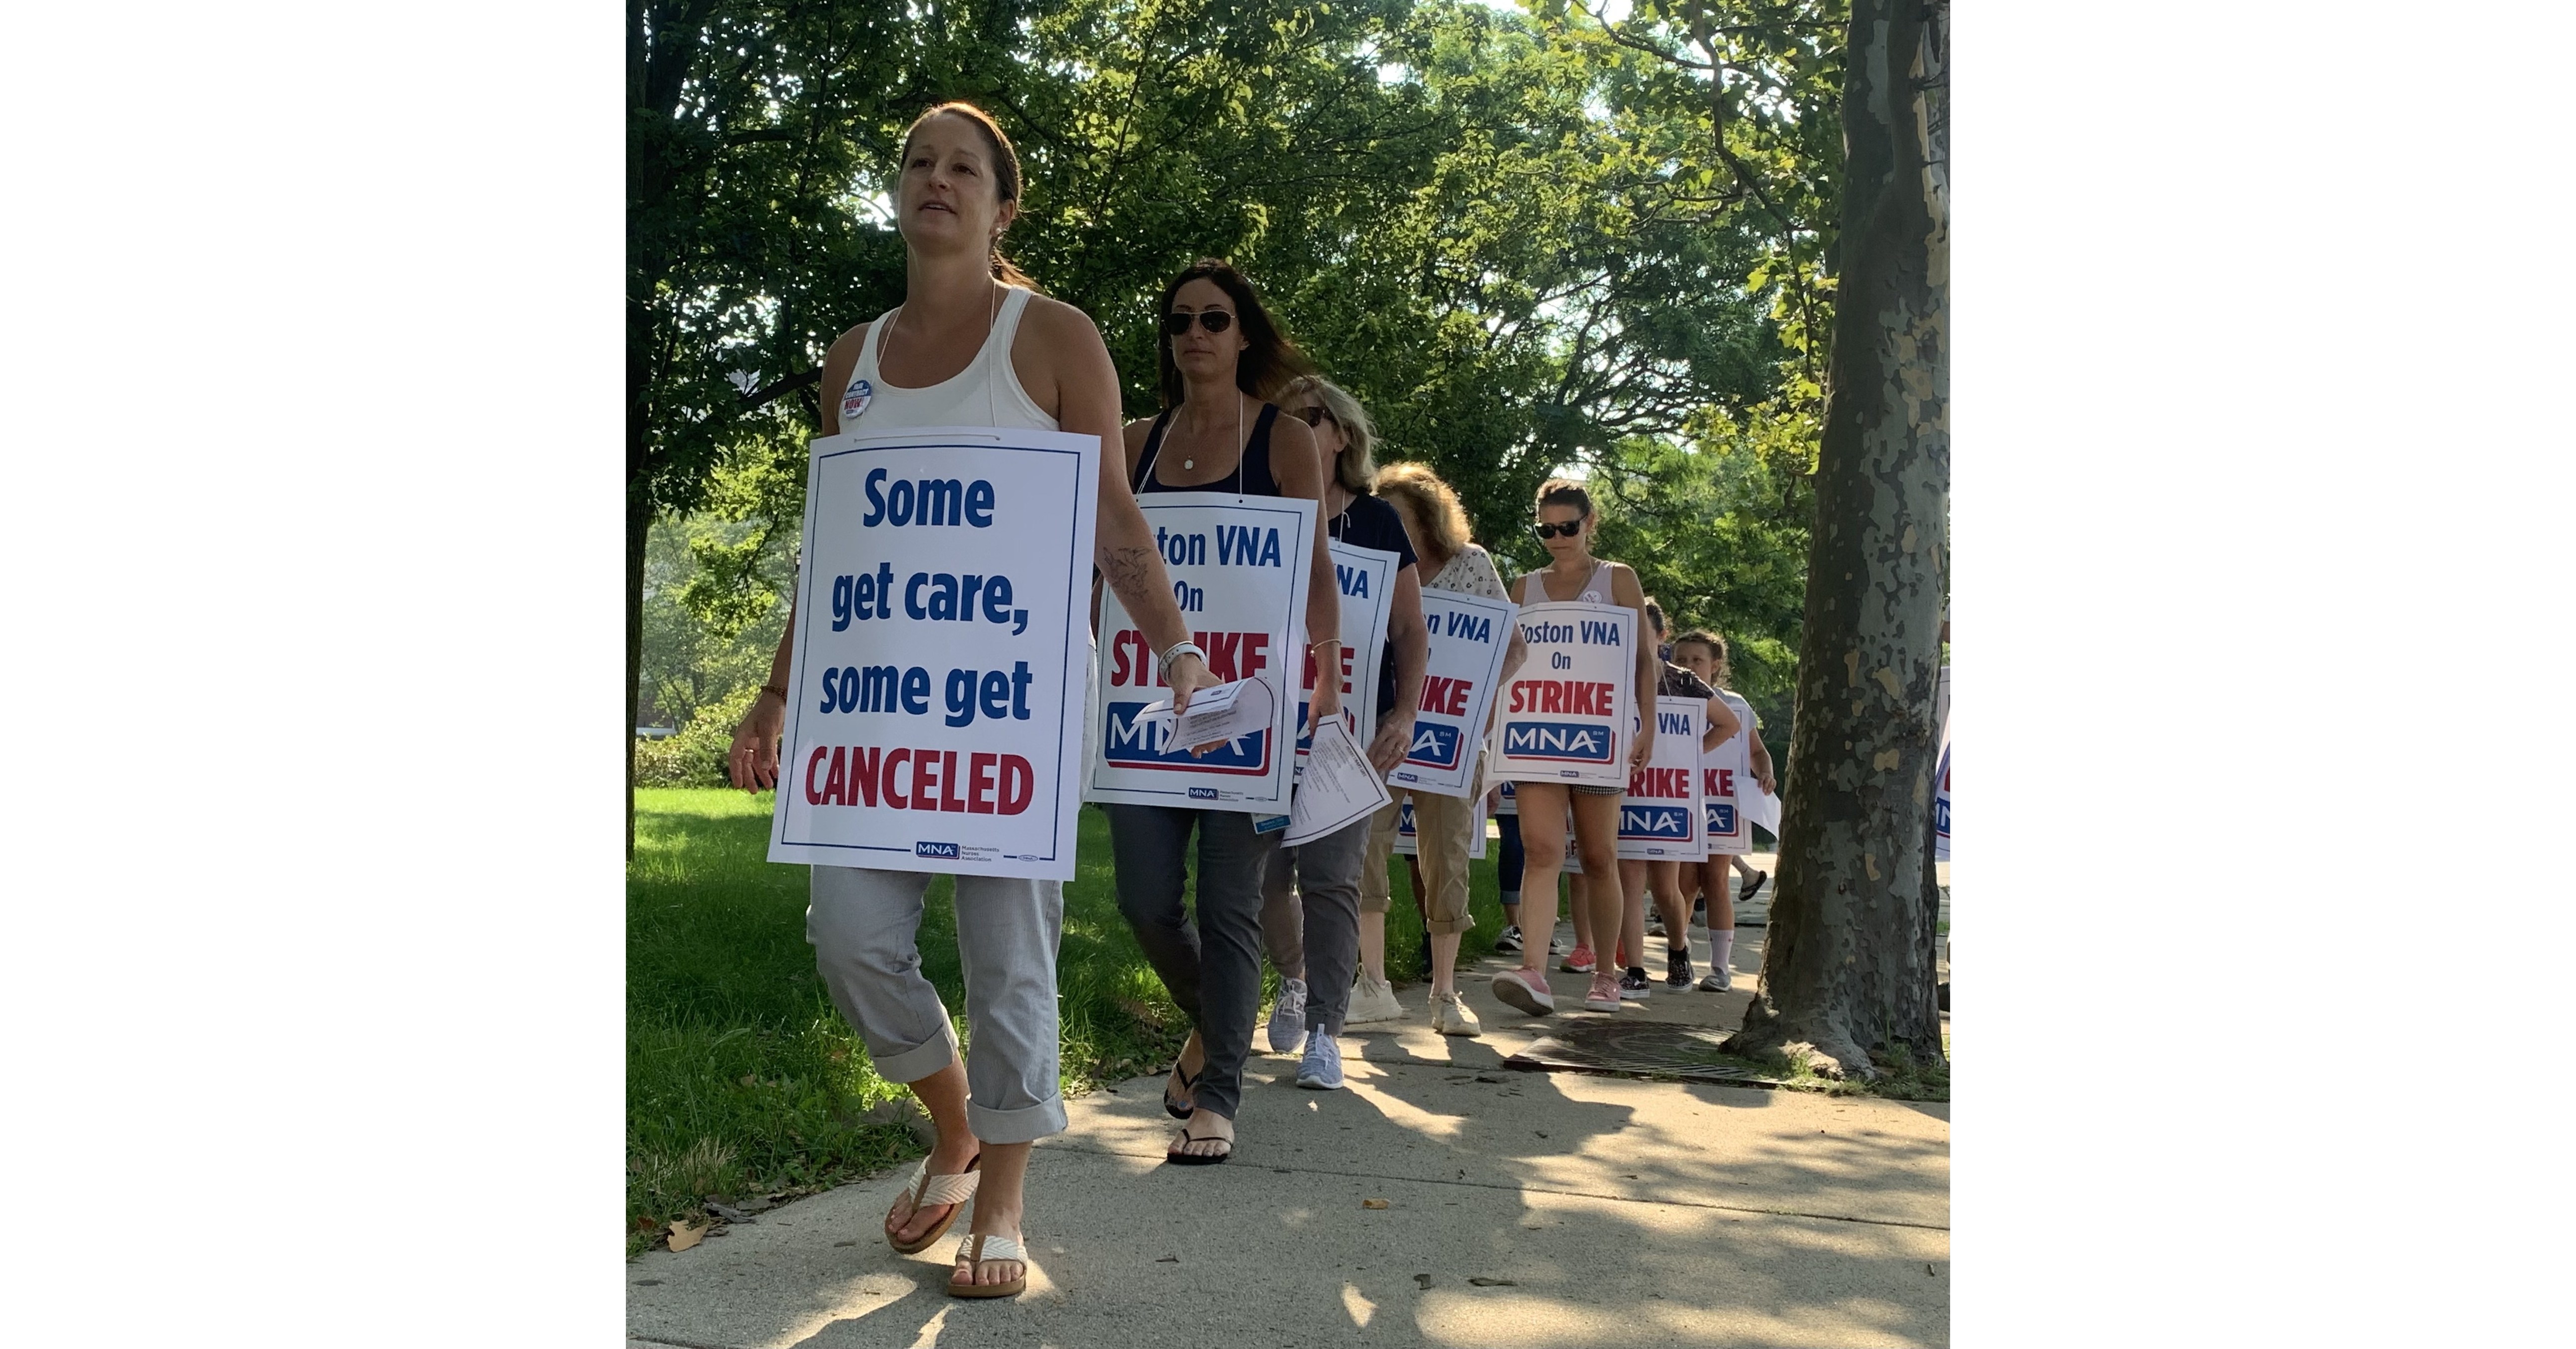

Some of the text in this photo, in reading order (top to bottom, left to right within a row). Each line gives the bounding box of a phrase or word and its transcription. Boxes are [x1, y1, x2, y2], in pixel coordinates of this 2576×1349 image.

[863, 468, 995, 528] Some
[1155, 525, 1281, 568] ton VNA
[1335, 564, 1369, 599] NA
[832, 562, 1029, 636] get care,
[1448, 611, 1491, 644] VNA
[1580, 621, 1620, 647] VNA
[1551, 652, 1571, 670] On
[820, 661, 1033, 727] some get
[1509, 680, 1614, 716] STRIKE
[1508, 727, 1601, 753] MNA
[1658, 713, 1691, 736] VNA
[805, 746, 1034, 816] CANCELED
[1189, 788, 1215, 797] MNA
[1627, 767, 1690, 799] RIKE
[1620, 811, 1681, 832] NA
[918, 843, 955, 855] MNA
